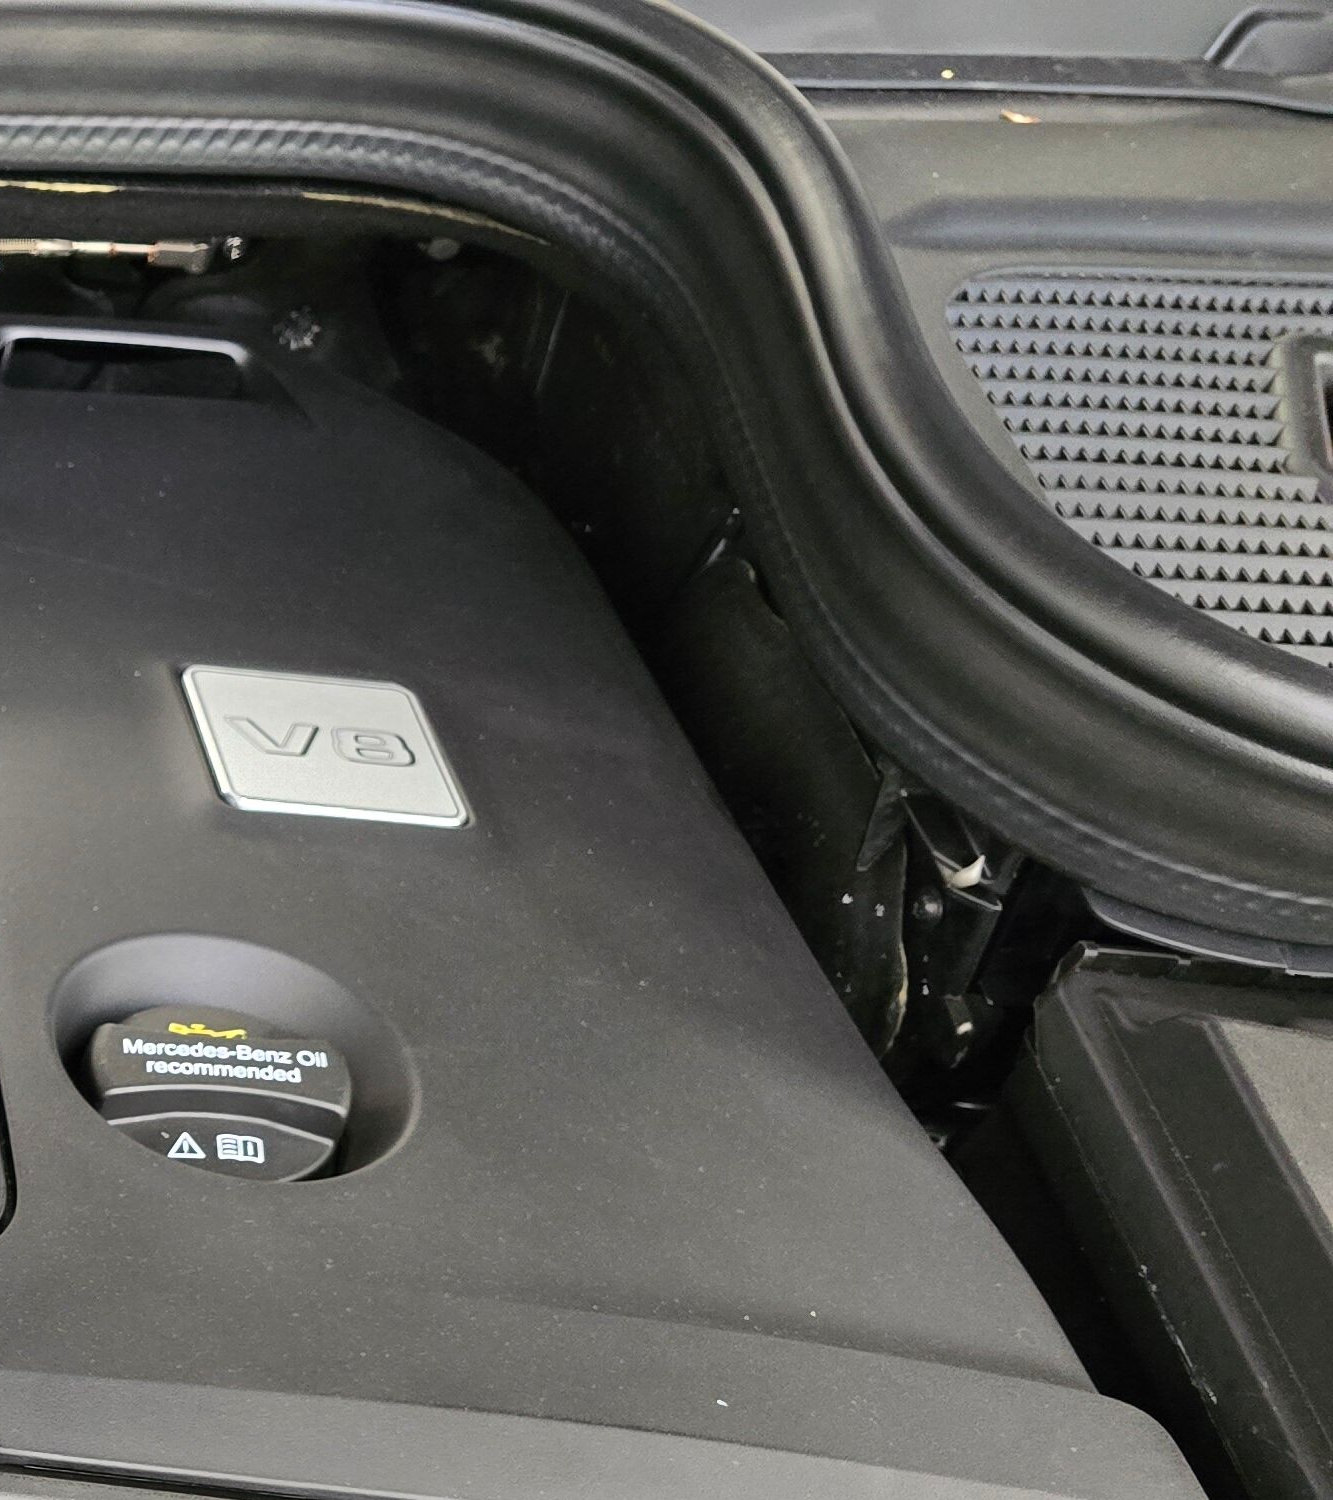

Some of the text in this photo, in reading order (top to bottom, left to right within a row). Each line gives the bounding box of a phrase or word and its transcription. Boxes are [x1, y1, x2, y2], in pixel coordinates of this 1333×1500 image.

[226, 717, 416, 767] V8
[123, 1038, 328, 1069] Mercedes-Benz Oil
[146, 1058, 302, 1084] recommended
